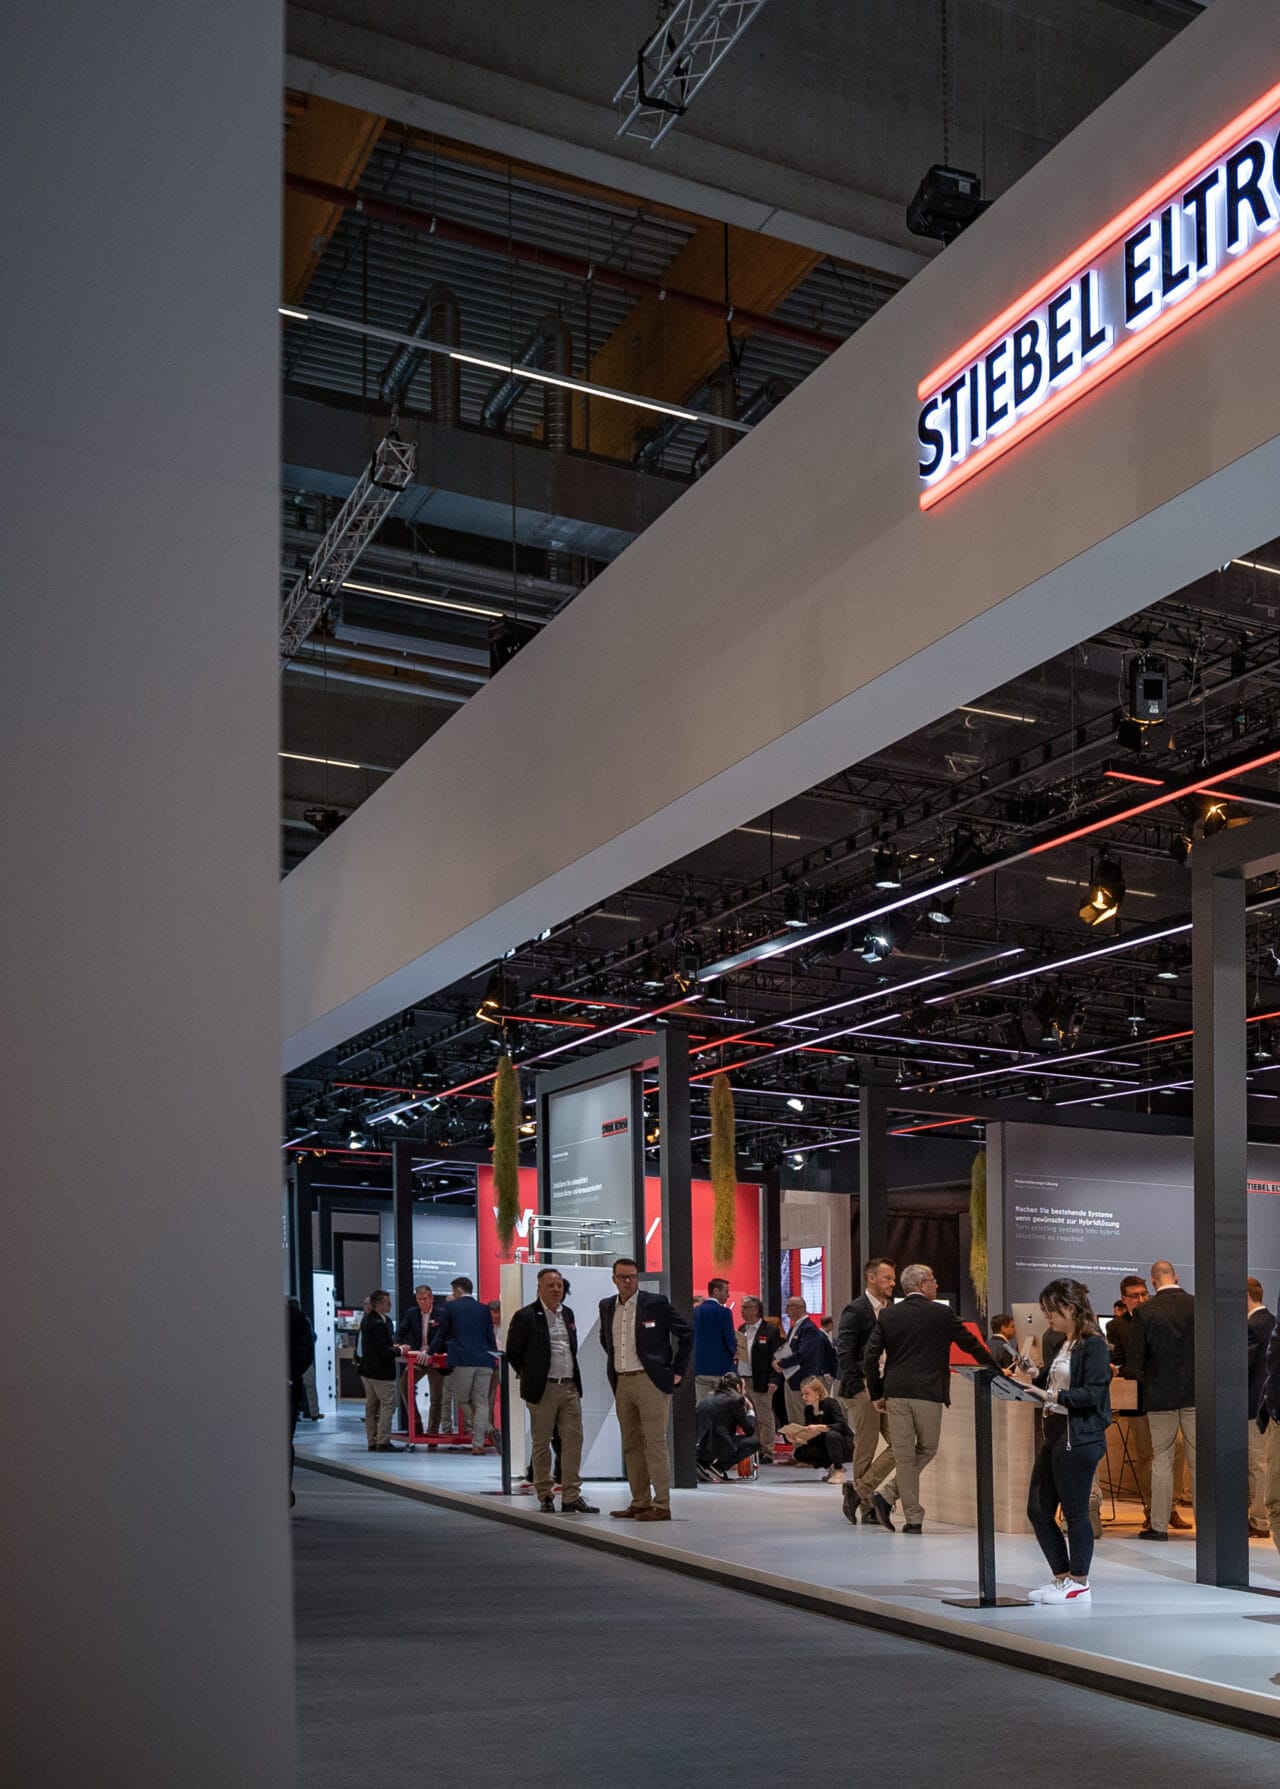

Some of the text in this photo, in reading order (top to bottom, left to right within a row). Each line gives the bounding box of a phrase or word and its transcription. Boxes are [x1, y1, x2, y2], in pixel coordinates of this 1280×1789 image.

[918, 270, 1112, 479] STIEBEL
[1015, 1205, 1113, 1219] Machen Sie bestehende Systeme
[1032, 1216, 1065, 1225] gewünscht
[1078, 1218, 1120, 1229] Hybridlösung
